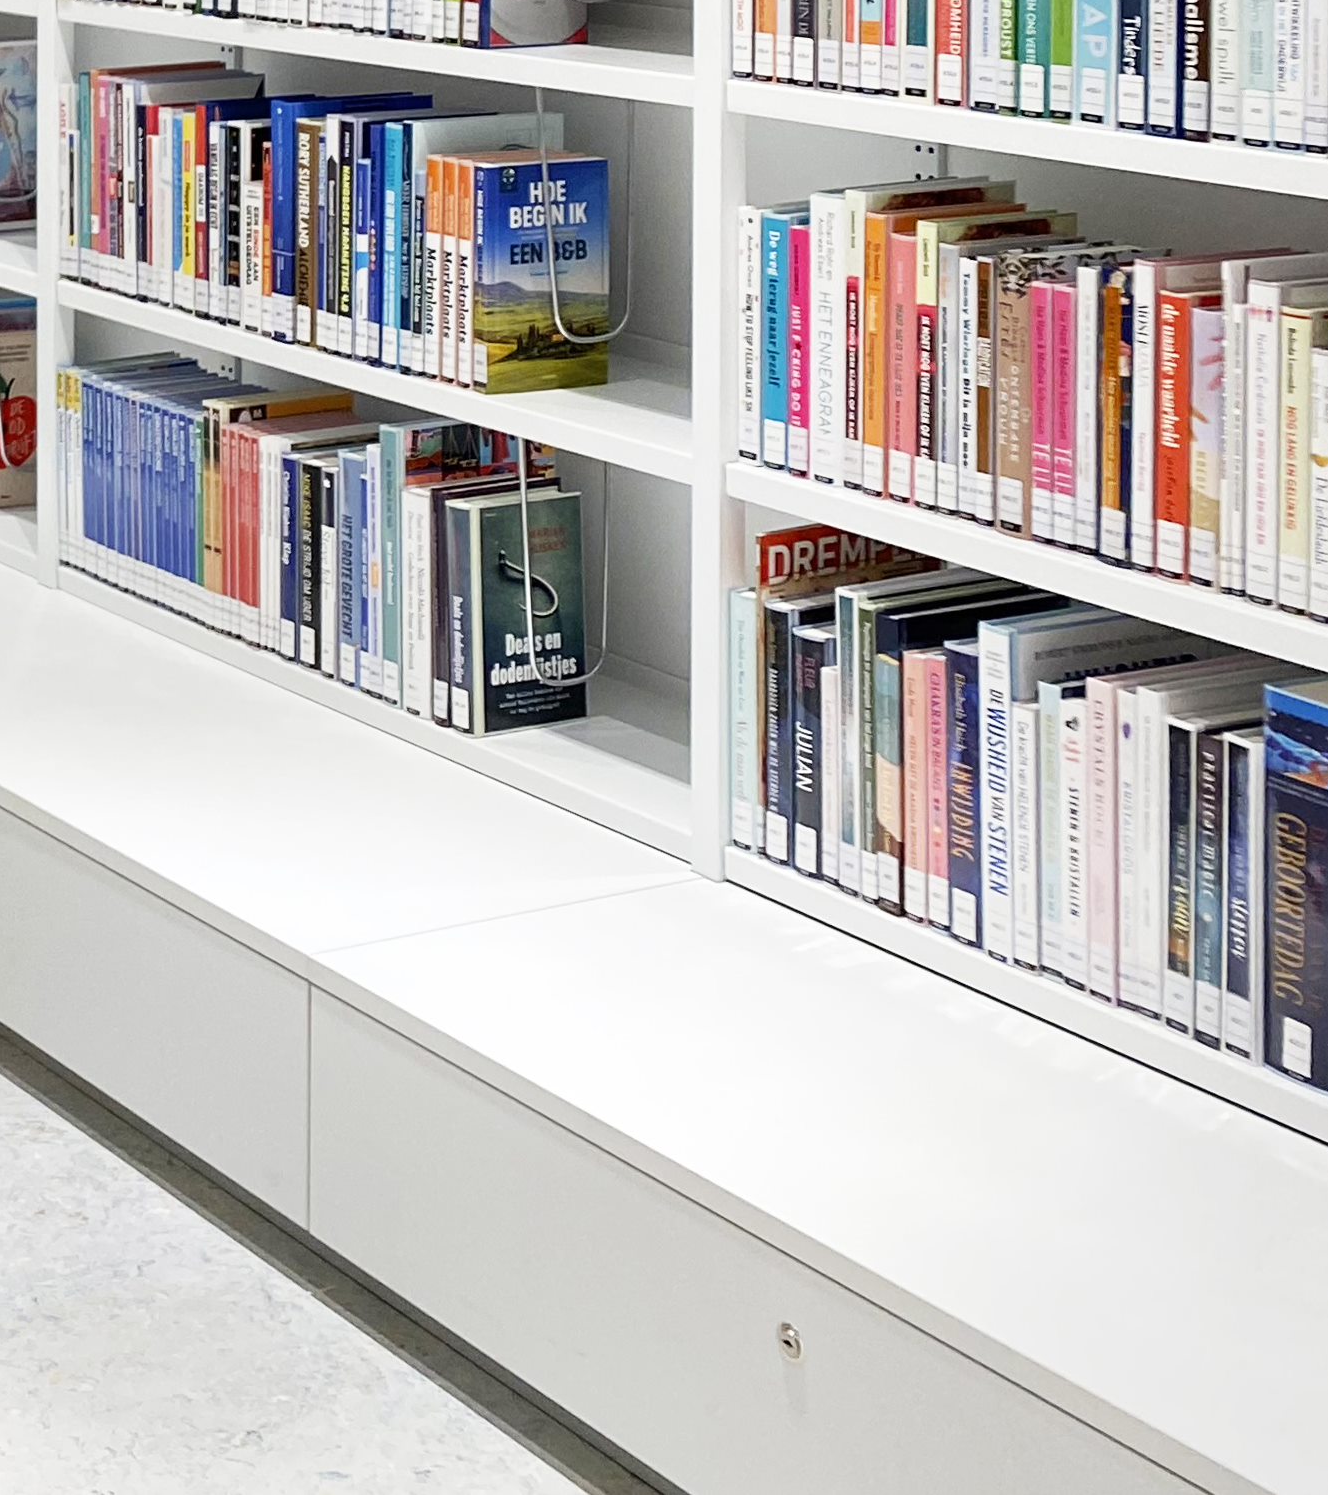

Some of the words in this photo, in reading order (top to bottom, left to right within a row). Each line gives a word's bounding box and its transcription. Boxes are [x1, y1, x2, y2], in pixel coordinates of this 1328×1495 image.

[1001, 0, 1013, 57] PROUST
[1026, 14, 1037, 35] ONS
[1122, 15, 1142, 75] Tinders
[297, 132, 311, 165] RORY
[297, 167, 311, 248] SUTHERLAND
[341, 165, 351, 222] HANDBOEK
[509, 202, 565, 229] BEGN
[569, 201, 588, 225] IK
[341, 226, 351, 291] MARKETING
[510, 242, 544, 265] EEN
[768, 230, 782, 249] De
[766, 251, 780, 275] weg
[425, 247, 438, 335] Marktplaats
[442, 251, 453, 339] Marktplaats
[458, 255, 470, 344] Marktplaats
[767, 278, 781, 313] terug
[817, 291, 833, 324] HET
[768, 317, 780, 346] naar
[791, 305, 801, 330] JUST
[1162, 304, 1181, 323] de
[767, 348, 782, 389] jezelf
[1162, 325, 1180, 374] naakte
[791, 392, 801, 411] DO
[791, 415, 801, 426] IT
[1162, 379, 1182, 449] waarheid
[342, 514, 354, 537] HET
[342, 539, 353, 580] GROTE
[768, 533, 913, 585] DREMP
[341, 582, 353, 639] GEVECHT
[505, 632, 542, 657] Deas
[545, 632, 562, 650] en
[930, 673, 942, 734] CHAKRAS
[988, 688, 1005, 704] DE
[795, 720, 814, 793] JULIAN
[986, 706, 1010, 793] WIJSHEID
[951, 760, 976, 862] INWIJDING
[991, 795, 1005, 820] VAN
[1069, 787, 1080, 829] STENEN
[988, 820, 1009, 896] STENEN
[1069, 846, 1081, 917] KRISTALLEN
[1273, 813, 1308, 1006] GEBOORTEDAG
